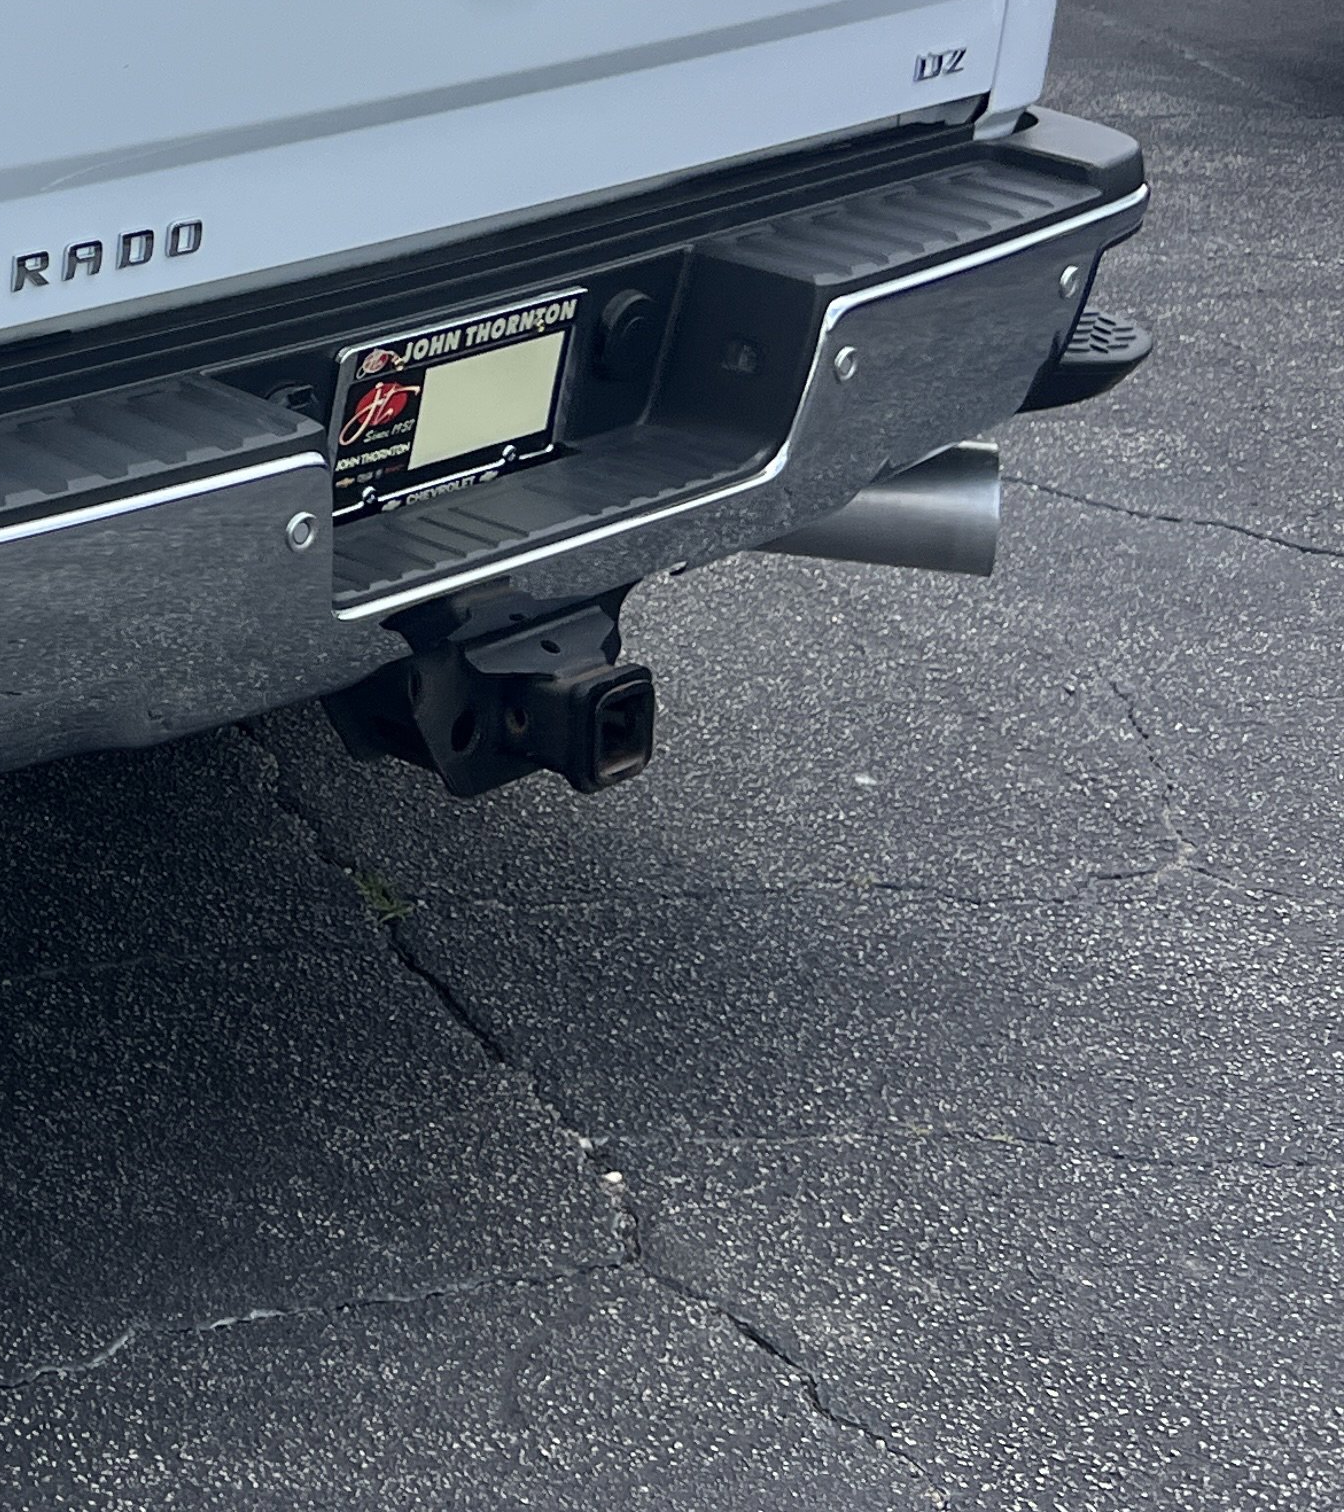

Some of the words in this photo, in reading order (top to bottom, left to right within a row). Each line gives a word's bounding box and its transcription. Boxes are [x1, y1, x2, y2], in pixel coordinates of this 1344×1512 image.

[402, 329, 462, 364] JOHN
[465, 299, 578, 347] THORNTON
[406, 475, 476, 505] CHEVROLET
